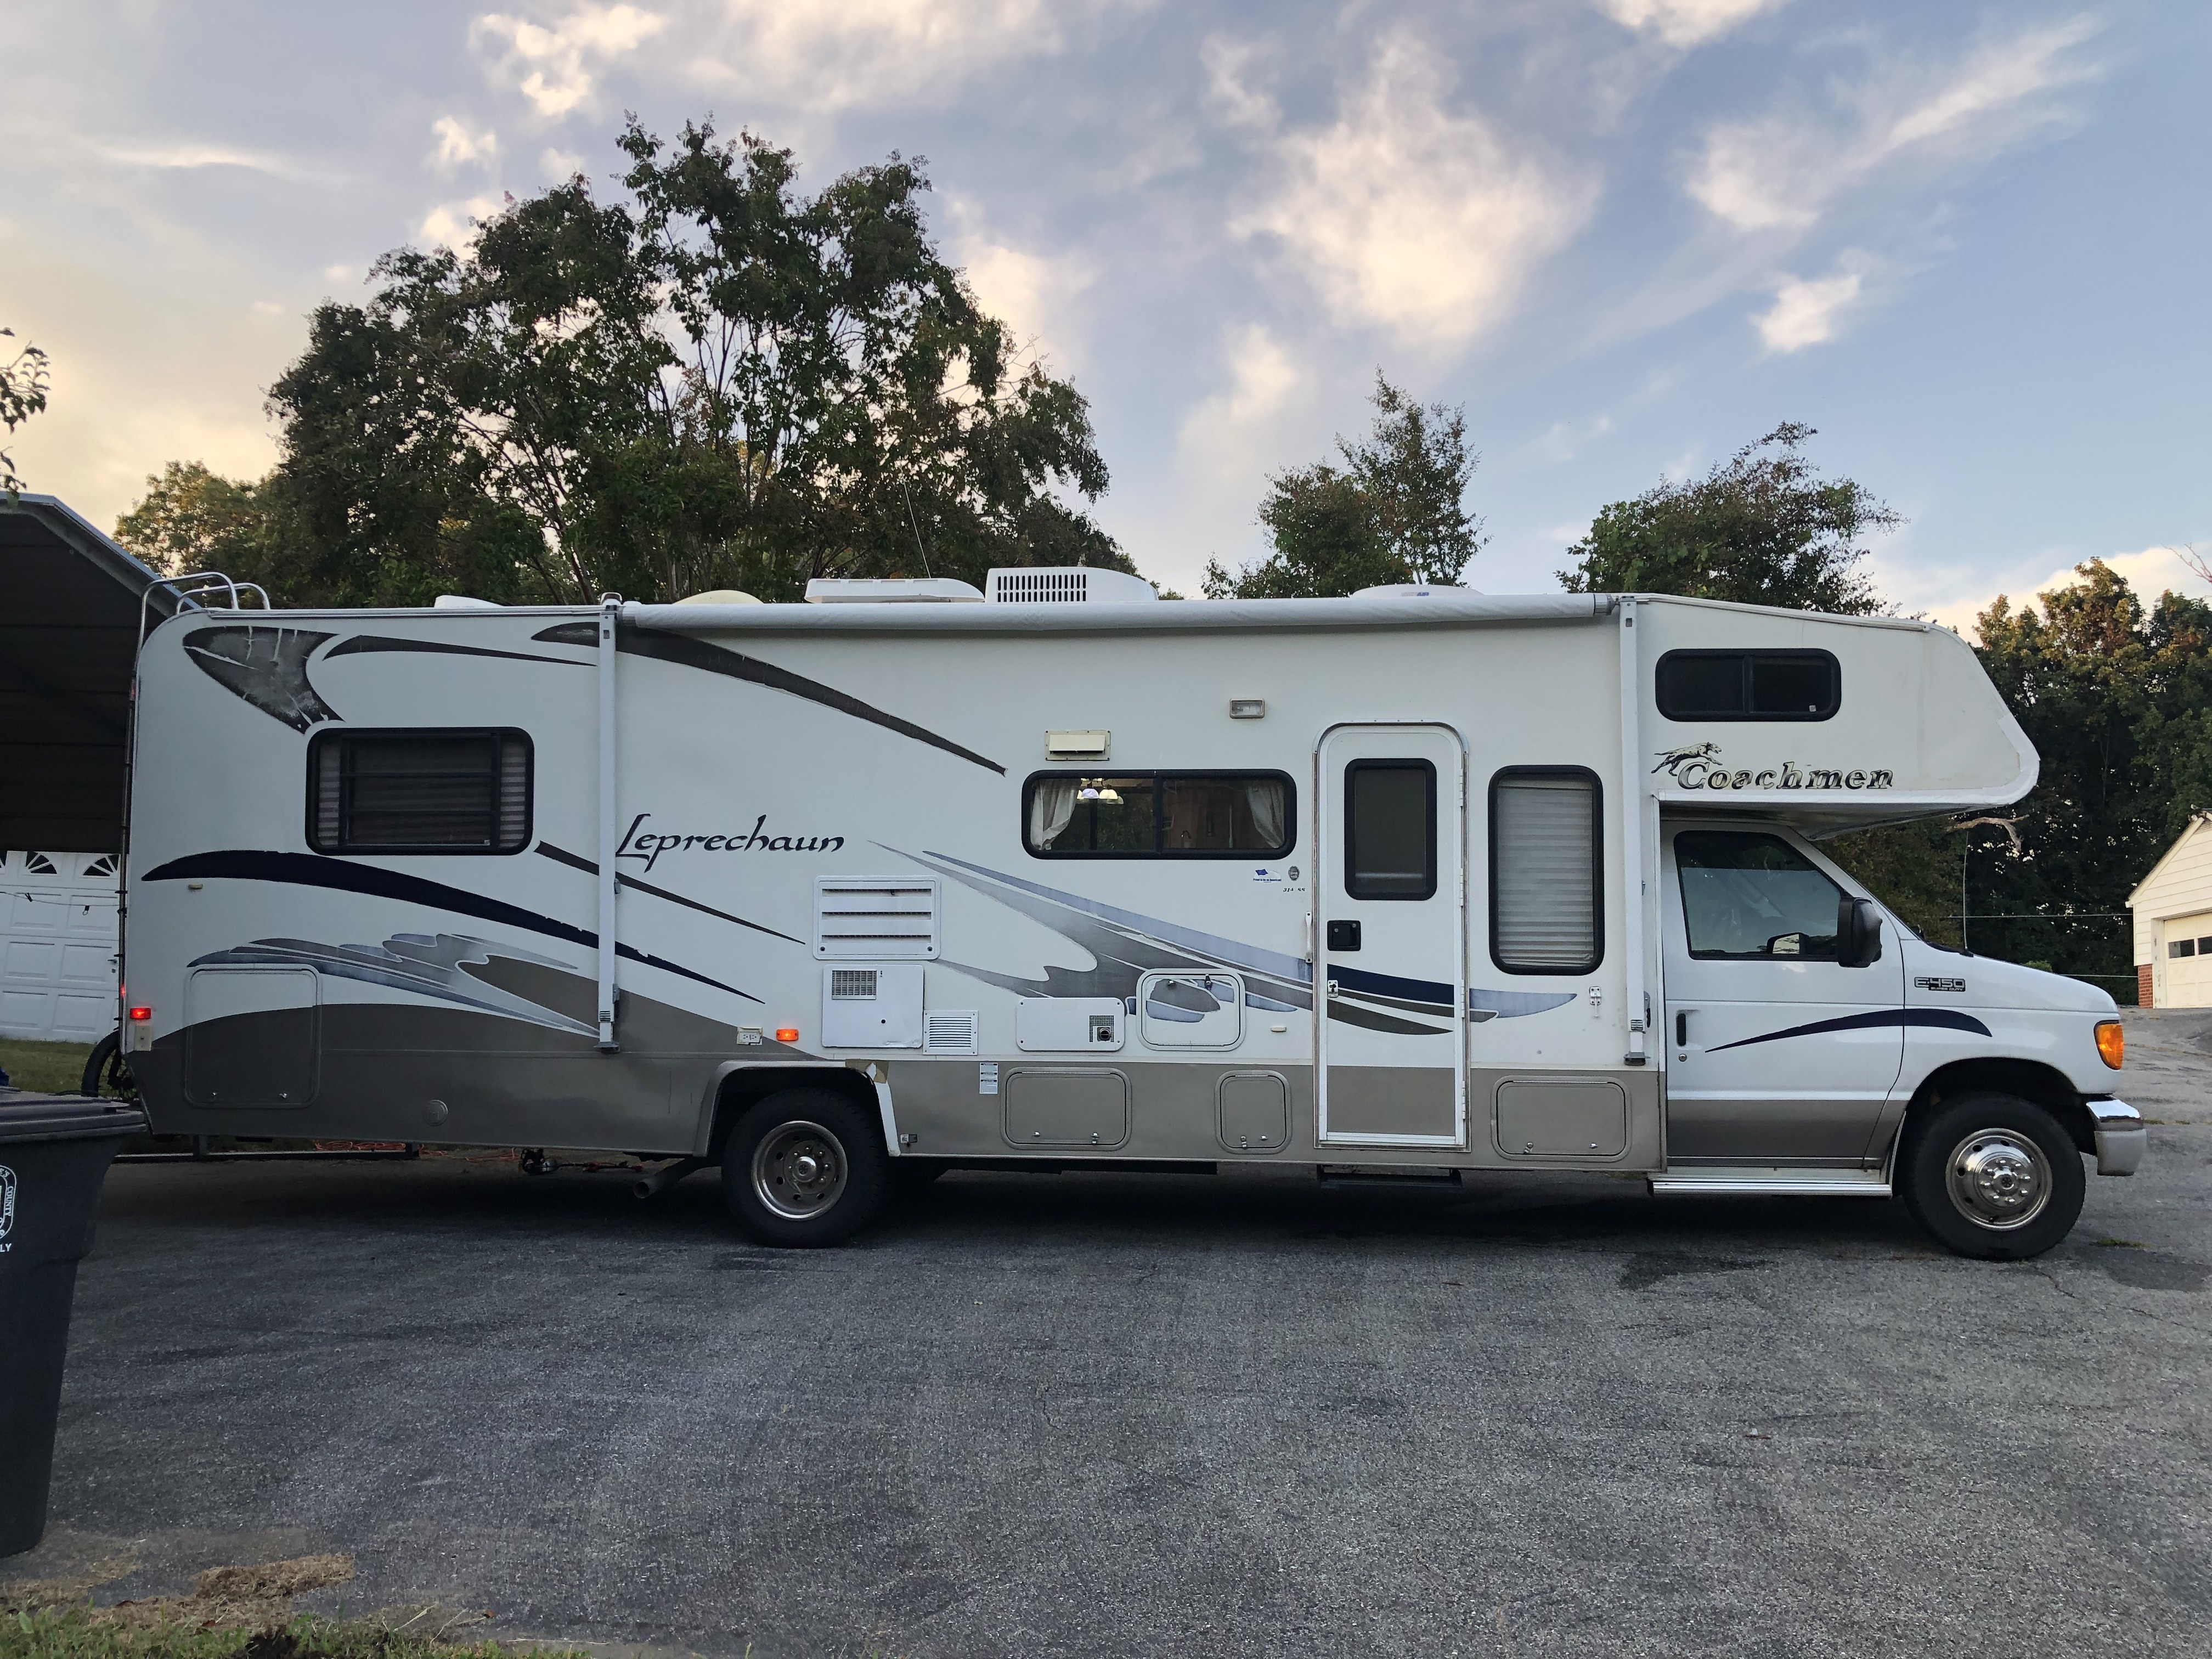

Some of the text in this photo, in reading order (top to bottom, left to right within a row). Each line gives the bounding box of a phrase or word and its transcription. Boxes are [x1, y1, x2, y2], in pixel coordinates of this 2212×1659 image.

[1677, 761, 1893, 790] Coachmen
[615, 813, 845, 873] Leprechaun
[4, 1186, 14, 1216] COUNTY
